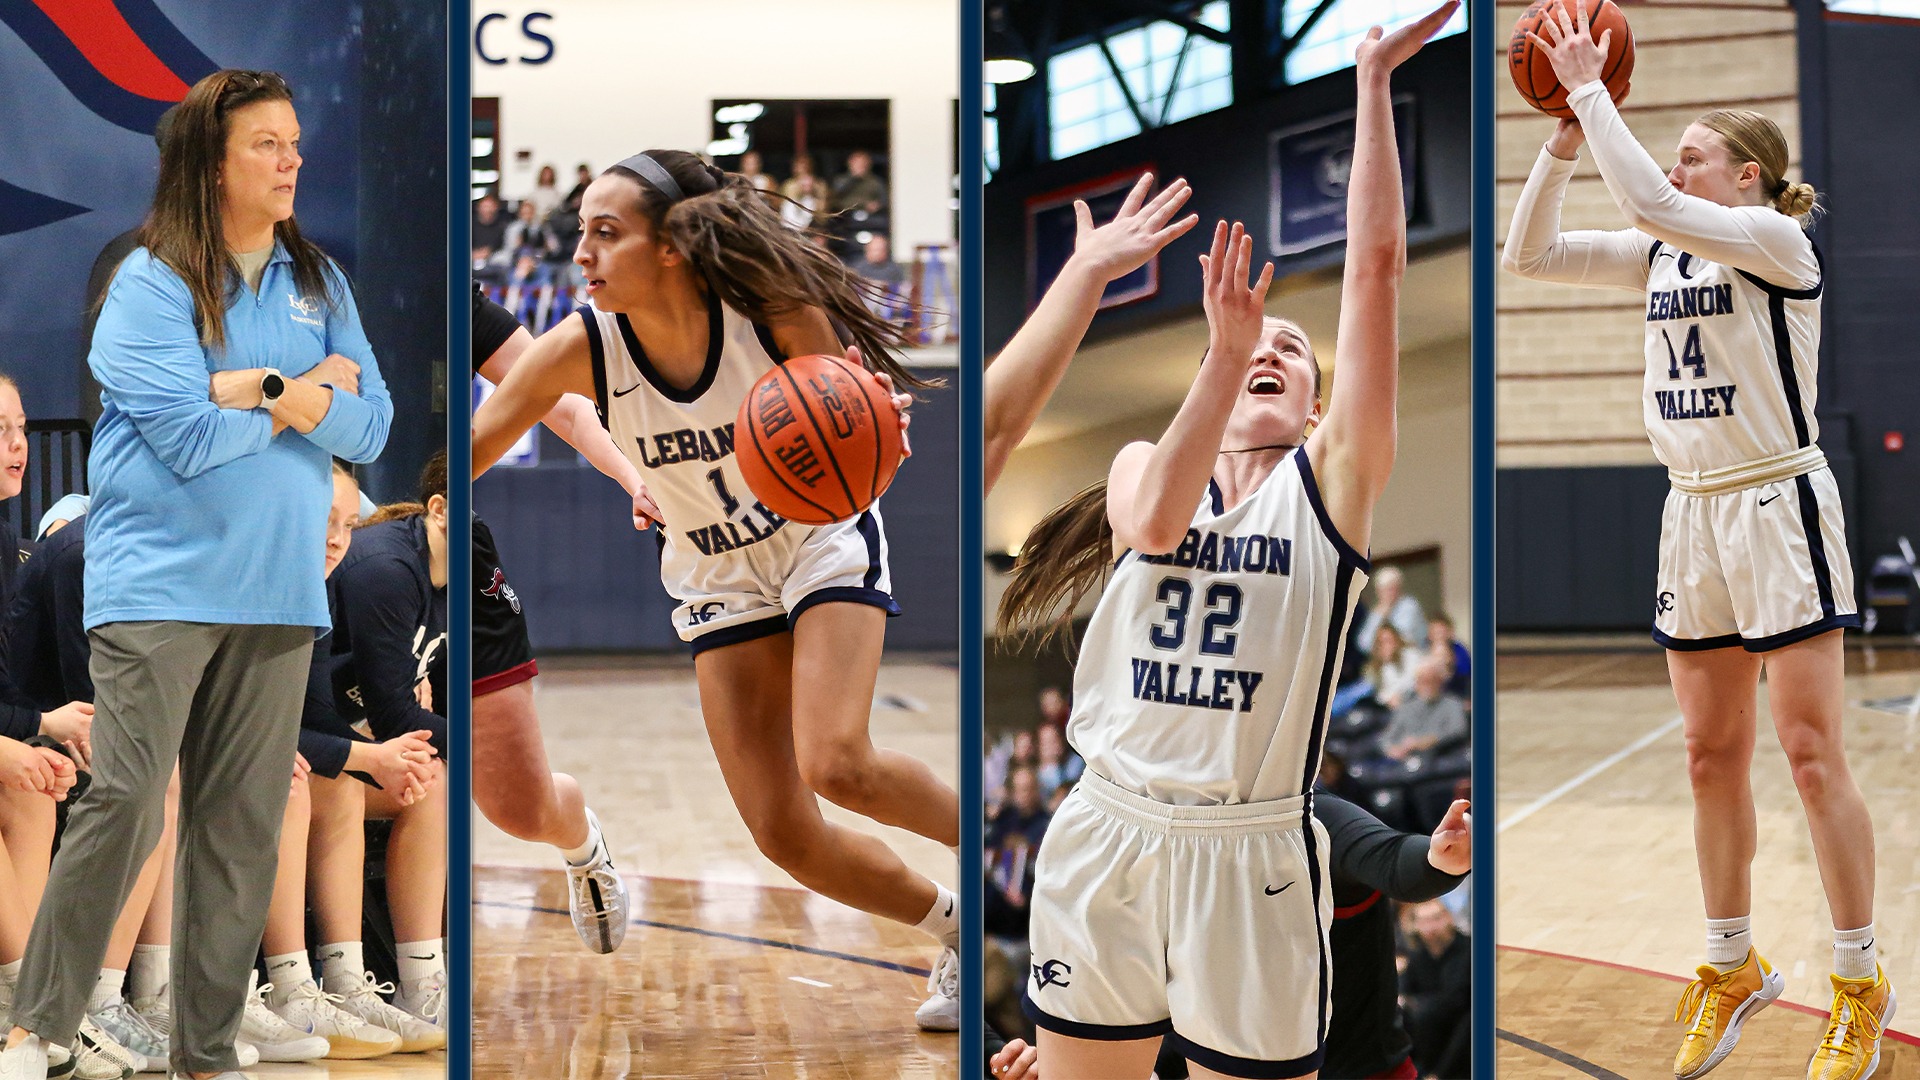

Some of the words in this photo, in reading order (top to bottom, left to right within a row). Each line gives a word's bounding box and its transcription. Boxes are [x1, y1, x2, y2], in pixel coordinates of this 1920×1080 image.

[475, 12, 554, 65] CS
[1647, 283, 1735, 322] EBANON
[1661, 323, 1708, 382] 14
[1655, 384, 1737, 421] VALLEY
[635, 421, 736, 469] LEBAN
[774, 433, 827, 489] THE
[706, 466, 741, 519] 1
[685, 500, 791, 556] VALLE
[1136, 527, 1292, 577] BANON
[1148, 575, 1245, 659] 32
[1131, 656, 1264, 714] VALLEY
